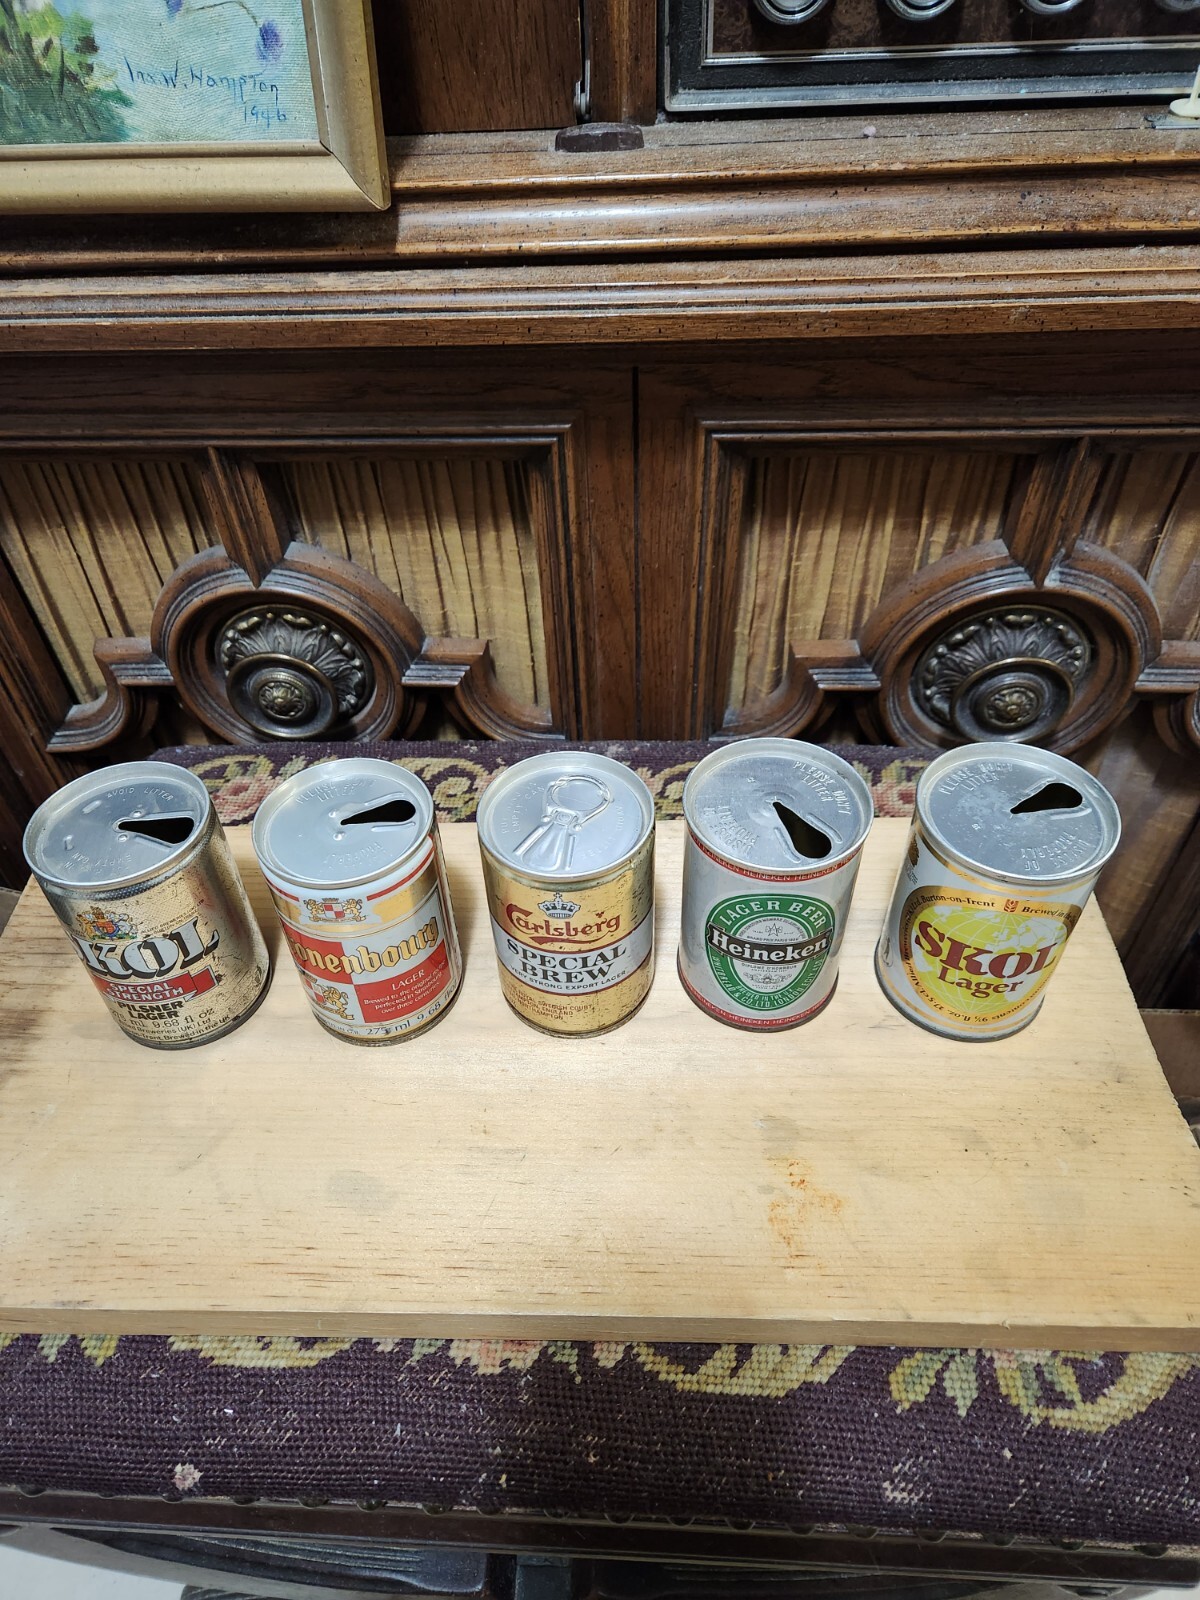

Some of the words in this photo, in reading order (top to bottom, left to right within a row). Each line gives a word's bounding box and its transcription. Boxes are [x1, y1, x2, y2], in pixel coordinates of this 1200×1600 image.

[243, 105, 287, 128] 1946
[938, 767, 974, 795] PLEASE
[961, 772, 1000, 791] LITTER
[106, 787, 135, 798] AVOID
[143, 787, 175, 802] LITTER
[743, 870, 790, 881] HEINEKEN
[795, 865, 838, 880] HEINEKEN
[921, 894, 996, 907] Burton-on-Trent
[506, 903, 621, 945] Carlsberg
[719, 901, 780, 926] LAGER
[788, 902, 827, 929] BEER
[506, 938, 627, 970] SPECIAL
[712, 929, 828, 962] Heineken
[915, 921, 1058, 979] SKOL
[391, 969, 425, 991] LAGER
[519, 958, 616, 984] BREW
[529, 976, 563, 990] STRONG
[565, 982, 598, 990] EXPORT
[601, 970, 626, 985] LAGER
[110, 982, 173, 993] SPECIAL
[363, 995, 390, 1005] Brewed
[399, 989, 410, 997] the
[411, 974, 433, 991] original
[937, 966, 1024, 999] Lager
[106, 986, 184, 1001] STRENGTH
[375, 996, 407, 1010] perfected
[407, 992, 414, 1000] in
[117, 1000, 184, 1012] PILSNER
[128, 1010, 179, 1020] LAGER
[381, 1006, 396, 1014] over
[397, 1000, 413, 1010] three
[395, 1020, 411, 1031] ml
[417, 1001, 441, 1021] 9.68
[729, 1014, 769, 1025] HEINEKEN
[772, 1010, 810, 1024] HEINEKEN
